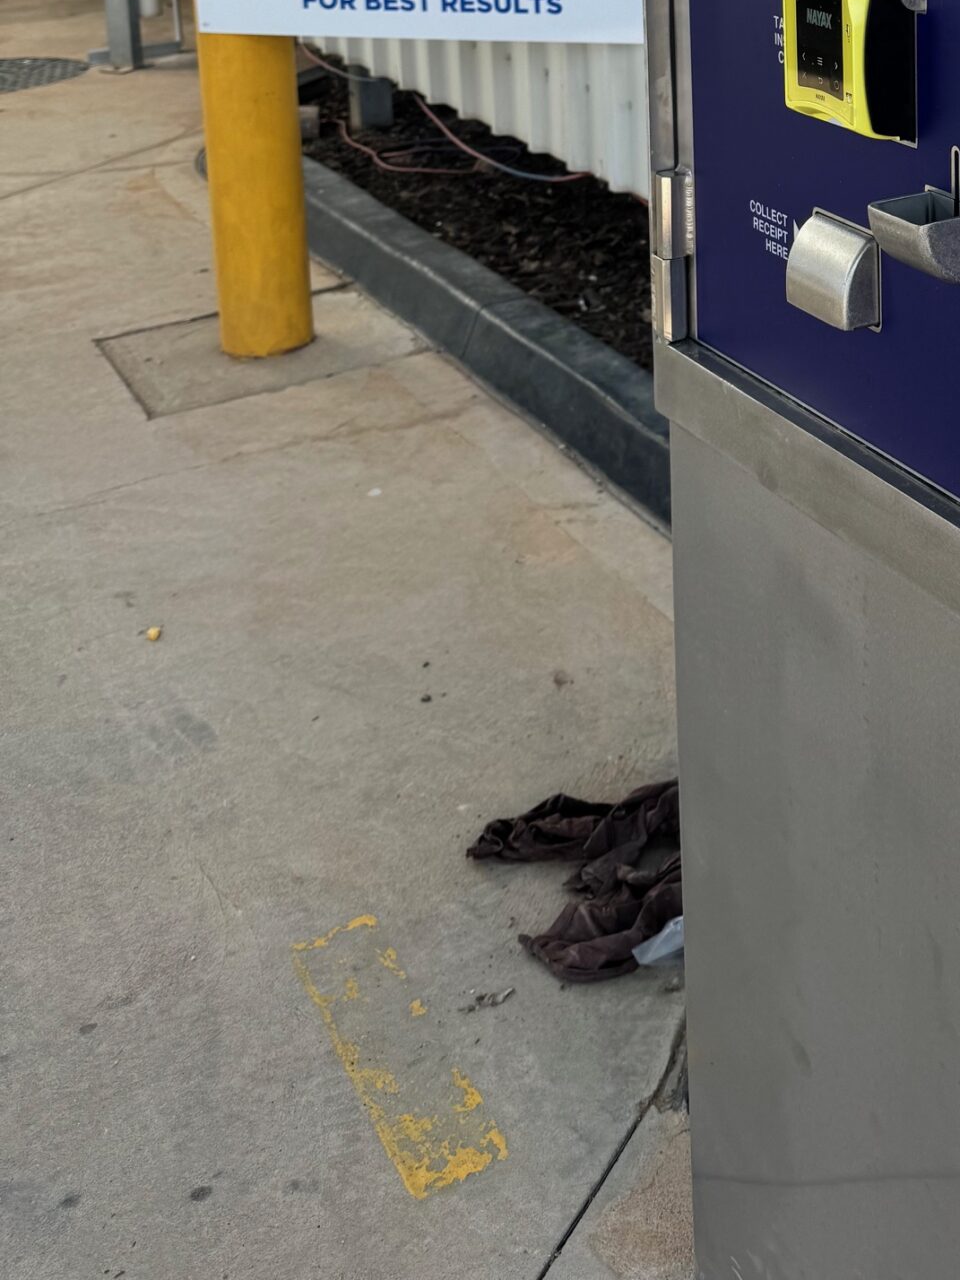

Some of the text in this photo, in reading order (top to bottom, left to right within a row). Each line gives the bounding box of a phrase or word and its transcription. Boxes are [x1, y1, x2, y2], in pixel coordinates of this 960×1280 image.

[806, 7, 832, 30] NAYAX
[749, 199, 788, 228] COLLECT
[752, 216, 789, 244] RECEIPT
[765, 237, 789, 261] HERE
